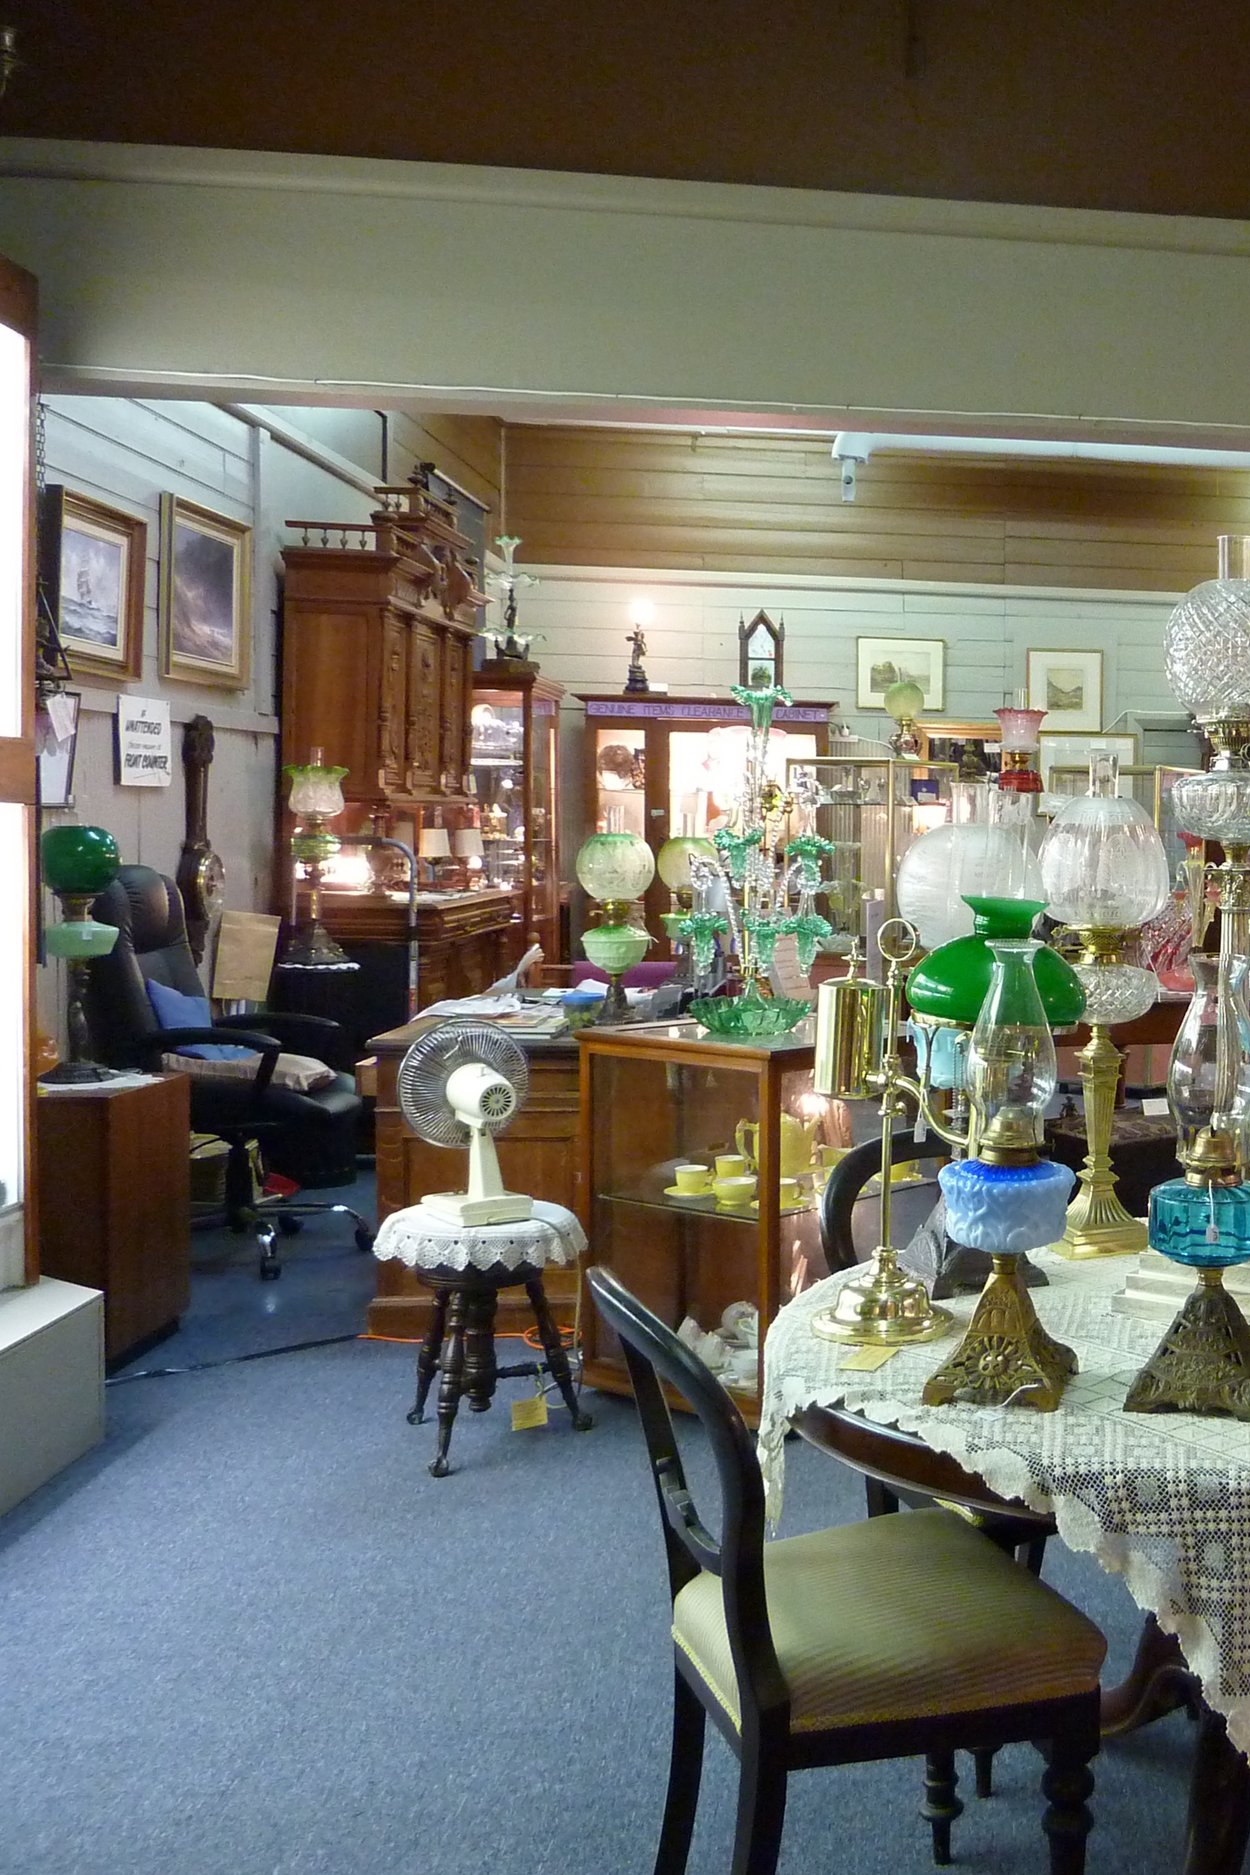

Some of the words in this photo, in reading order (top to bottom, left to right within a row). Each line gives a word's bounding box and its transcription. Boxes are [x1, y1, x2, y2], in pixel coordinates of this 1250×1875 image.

[589, 703, 636, 714] GENUINE
[643, 705, 675, 716] ITEMS
[681, 706, 744, 718] CLEARANCE
[776, 709, 820, 720] CABINET
[125, 720, 162, 735] UNATTENDED
[142, 755, 168, 770] COUNTER
